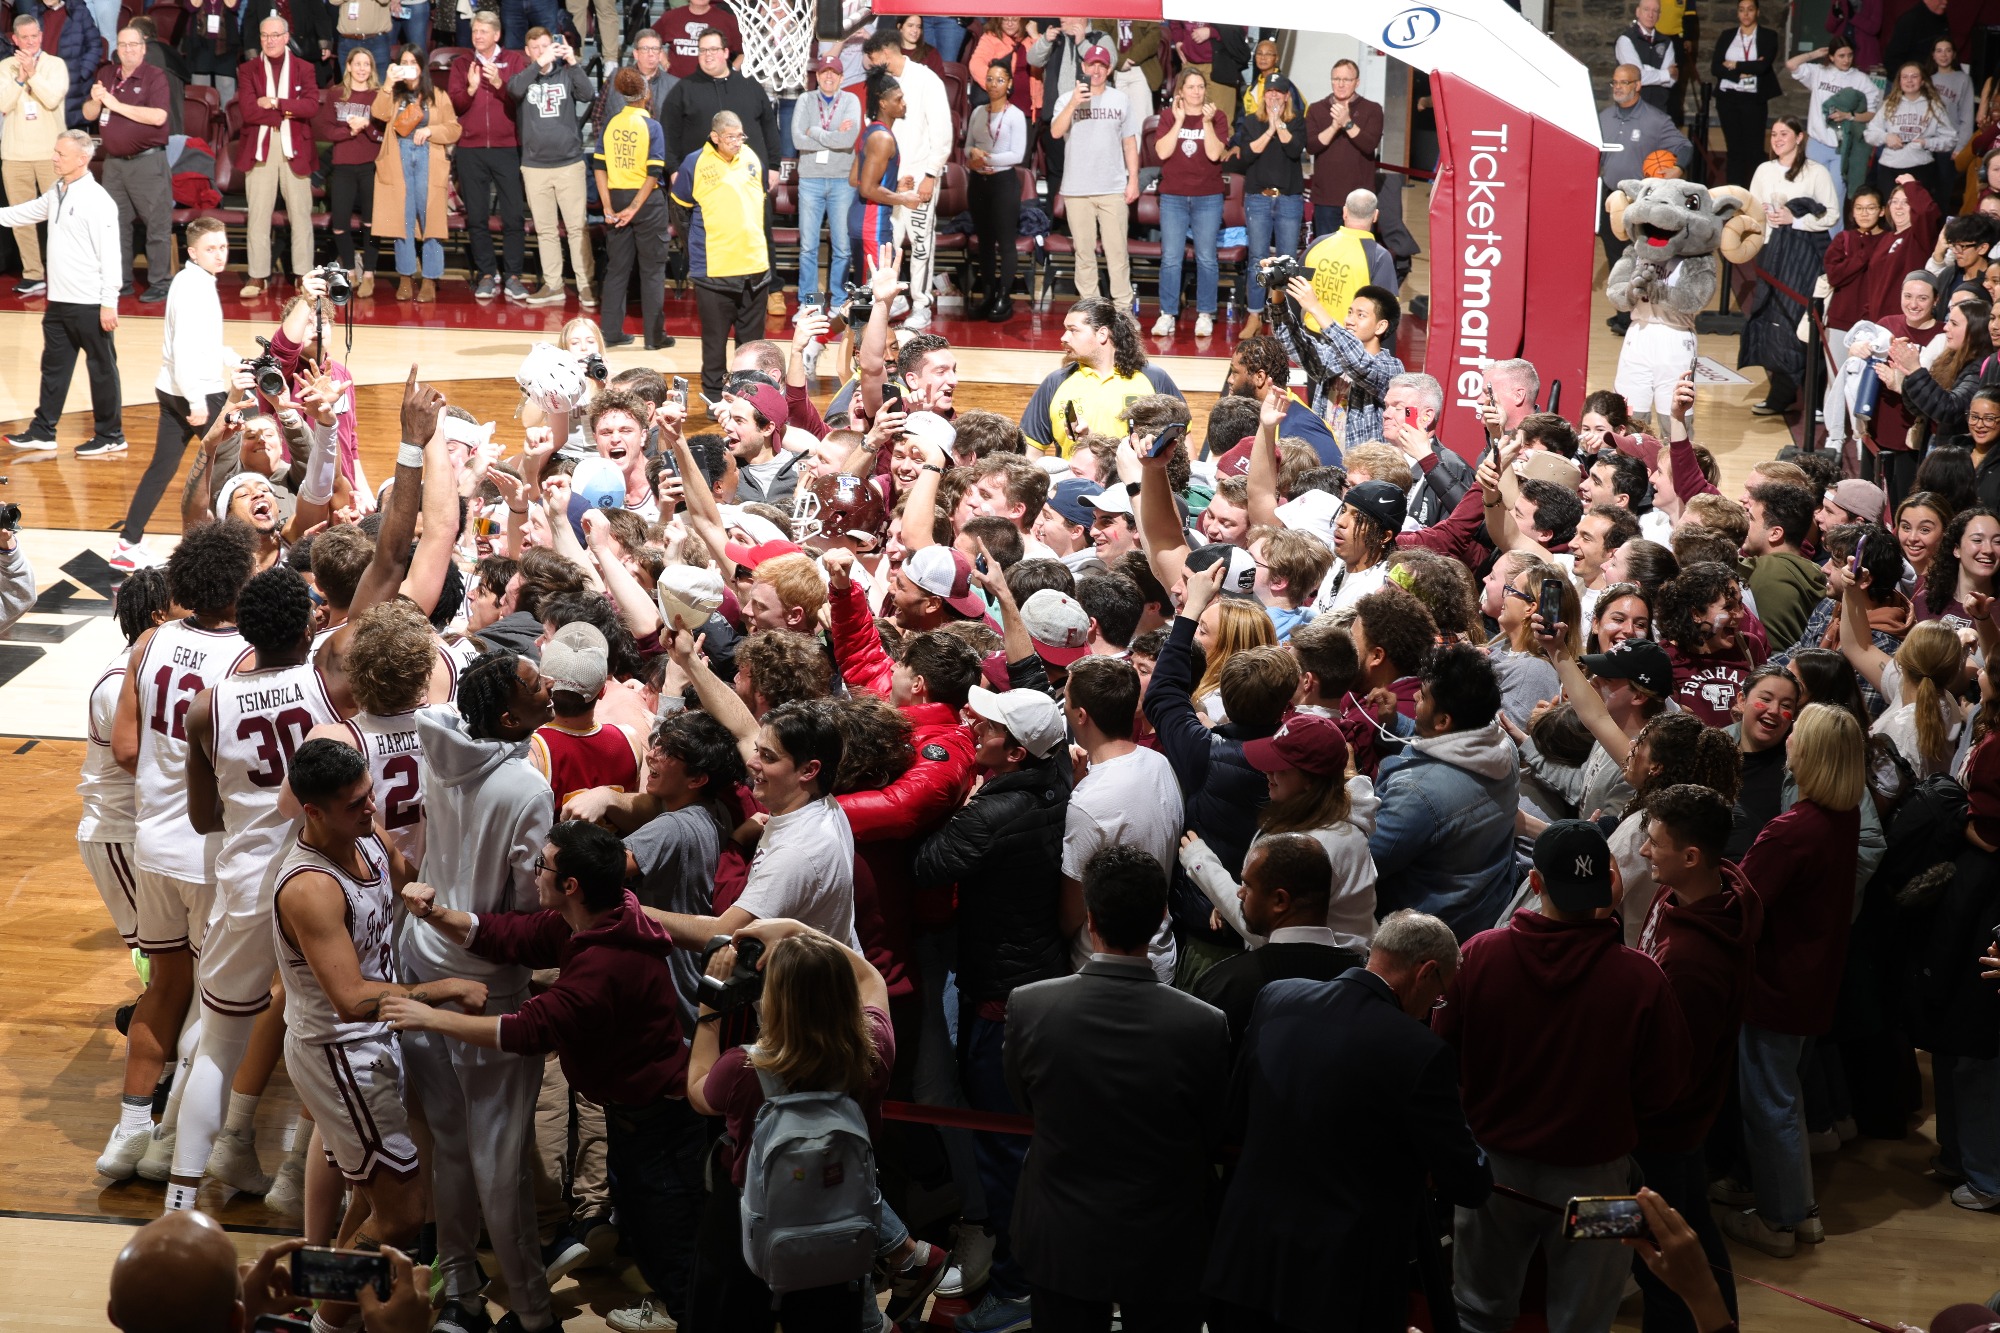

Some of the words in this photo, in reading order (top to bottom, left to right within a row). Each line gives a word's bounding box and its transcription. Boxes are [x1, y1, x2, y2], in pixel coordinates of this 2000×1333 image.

[1073, 107, 1122, 120] FORDHAM
[612, 128, 639, 144] CSC
[613, 142, 637, 158] EVENT
[614, 156, 636, 170] STAFF
[780, 161, 796, 181] F
[1317, 258, 1351, 278] CSC
[1456, 124, 1508, 414] TicketSmarter
[1315, 273, 1347, 294] EVENT
[1315, 288, 1343, 308] STAFF
[172, 645, 207, 671] GRAY
[1681, 666, 1745, 697] FORDHA
[150, 664, 206, 742] 12
[236, 682, 305, 714] TSIMBILA
[236, 706, 314, 788] 30
[375, 729, 423, 756] HARDE
[1574, 854, 1594, 878] NY
